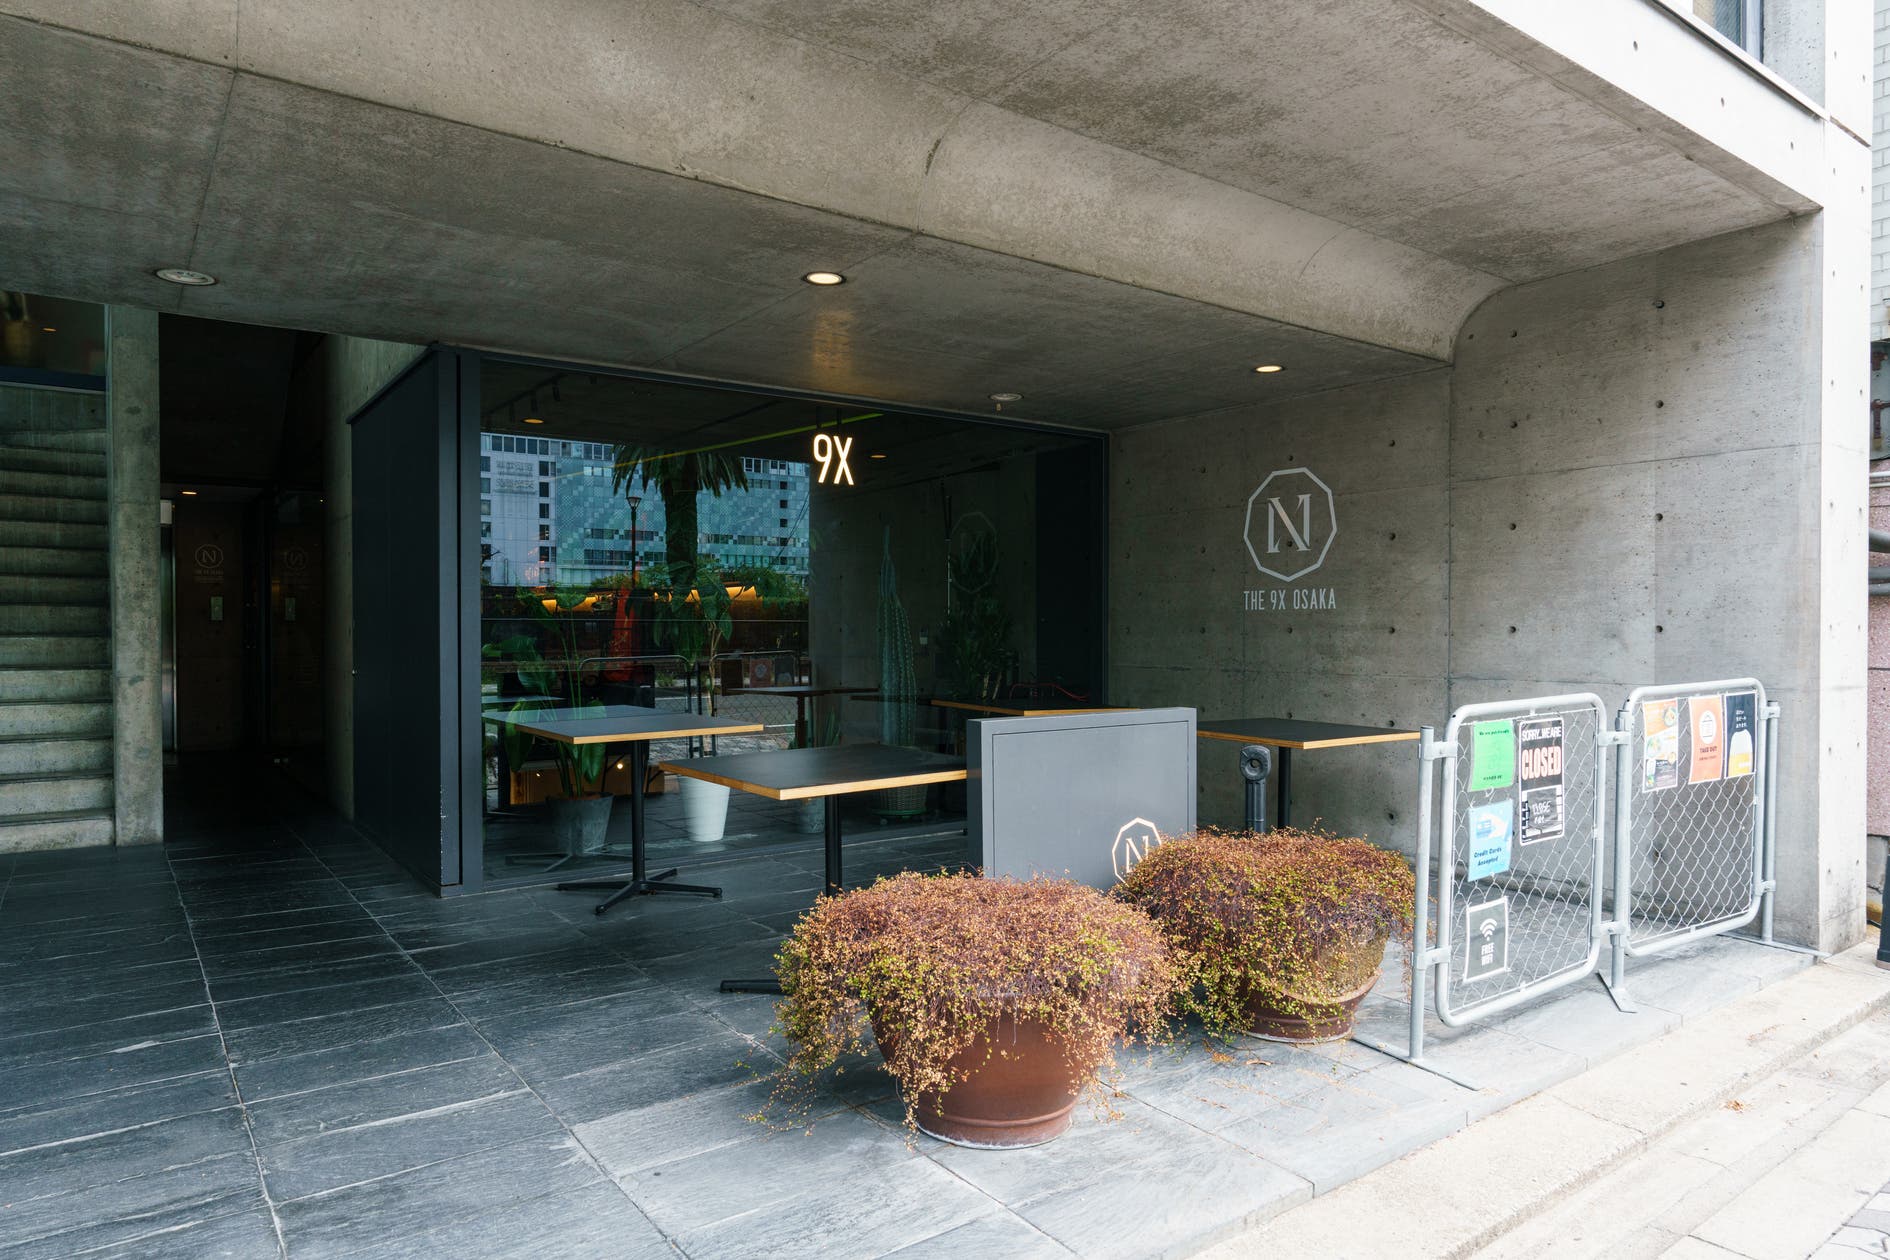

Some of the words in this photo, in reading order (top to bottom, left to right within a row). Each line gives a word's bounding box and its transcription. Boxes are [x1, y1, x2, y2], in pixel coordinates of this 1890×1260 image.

[813, 433, 855, 486] 9X
[1267, 494, 1312, 554] N
[1243, 590, 1265, 610] THE
[1270, 589, 1286, 610] 9X
[1293, 588, 1337, 610] OSAKA
[1521, 746, 1562, 780] CLOSED
[1474, 850, 1488, 858] Credit
[1489, 847, 1502, 855] Cards
[1481, 943, 1495, 955] FREE
